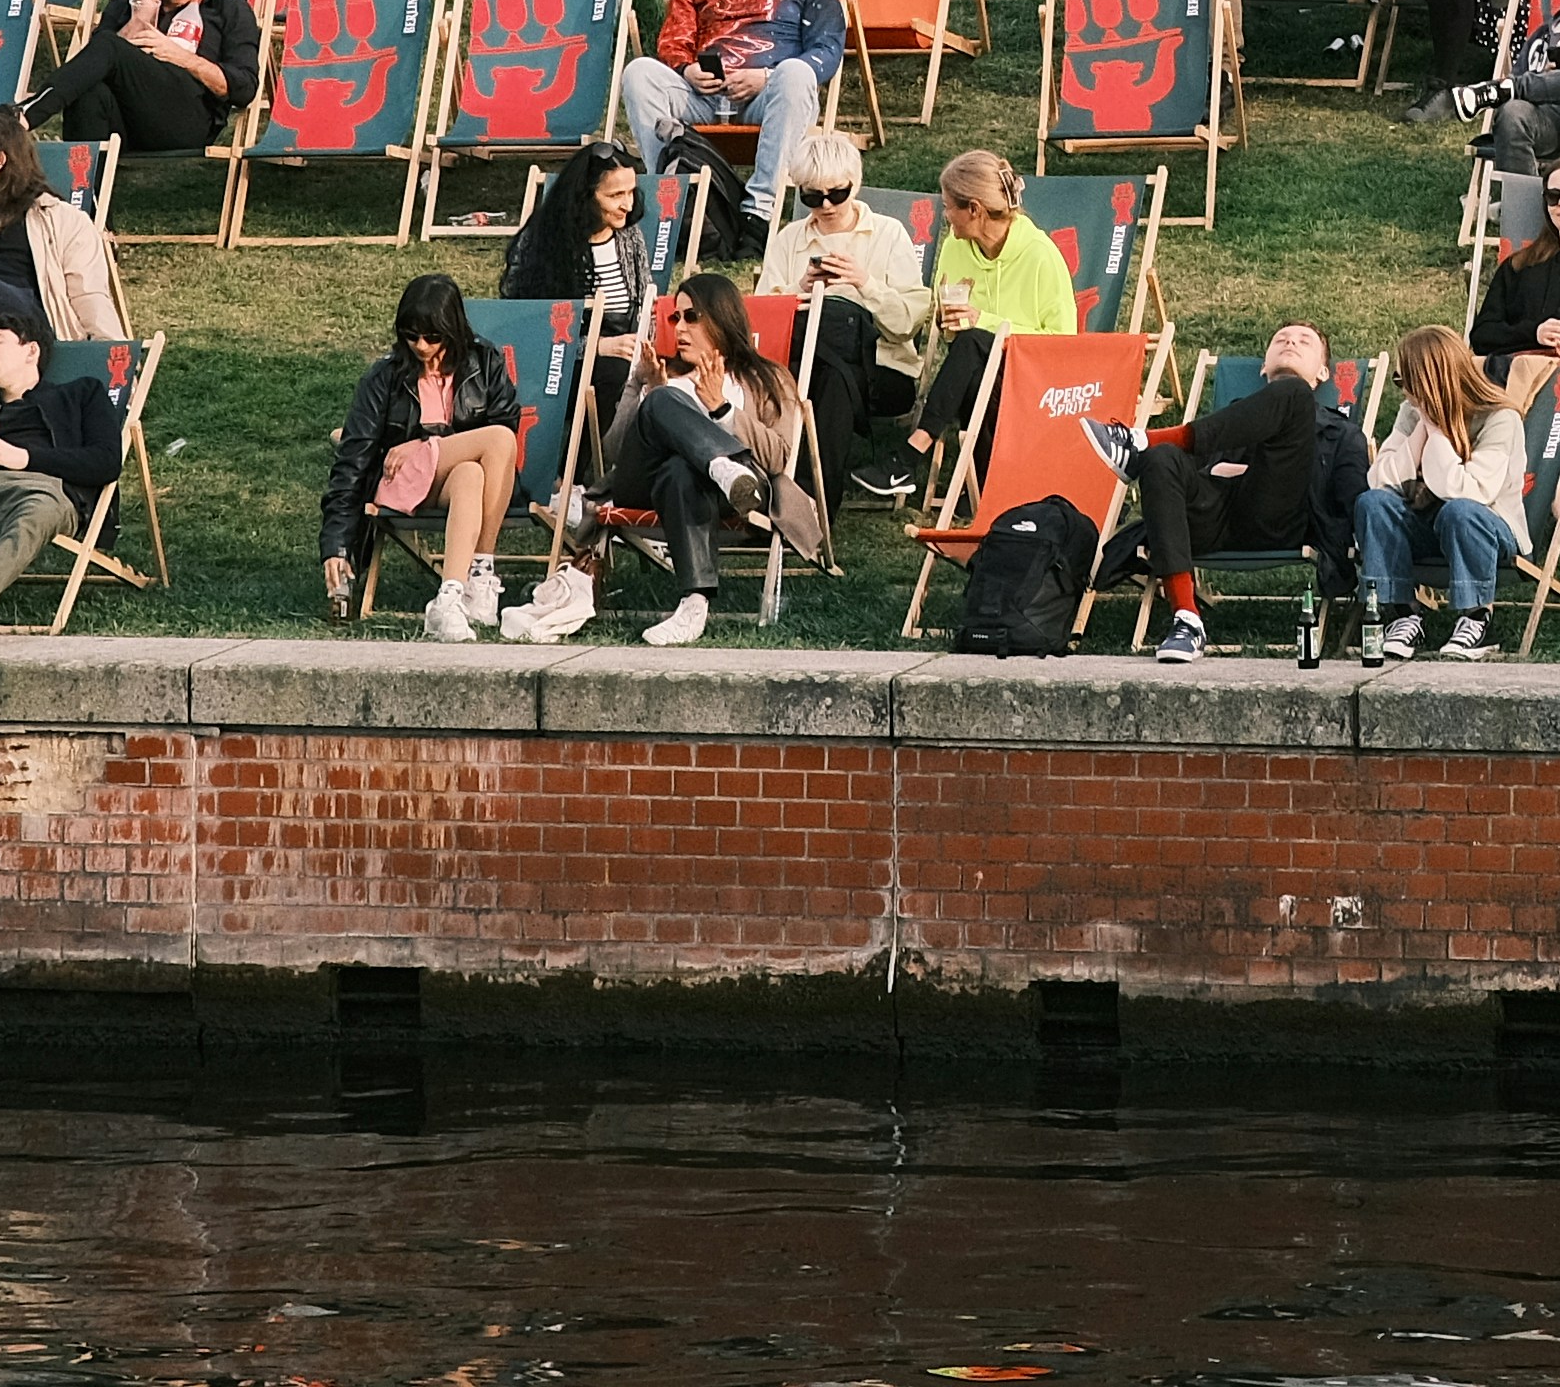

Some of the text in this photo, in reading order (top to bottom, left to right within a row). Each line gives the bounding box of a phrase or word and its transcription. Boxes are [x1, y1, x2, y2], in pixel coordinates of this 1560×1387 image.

[651, 221, 671, 271] BERLINER
[1106, 224, 1127, 274] BERLINER
[544, 343, 565, 395] BERLINER
[1038, 381, 1103, 410] APEROL
[1048, 398, 1091, 418] SPRITZ
